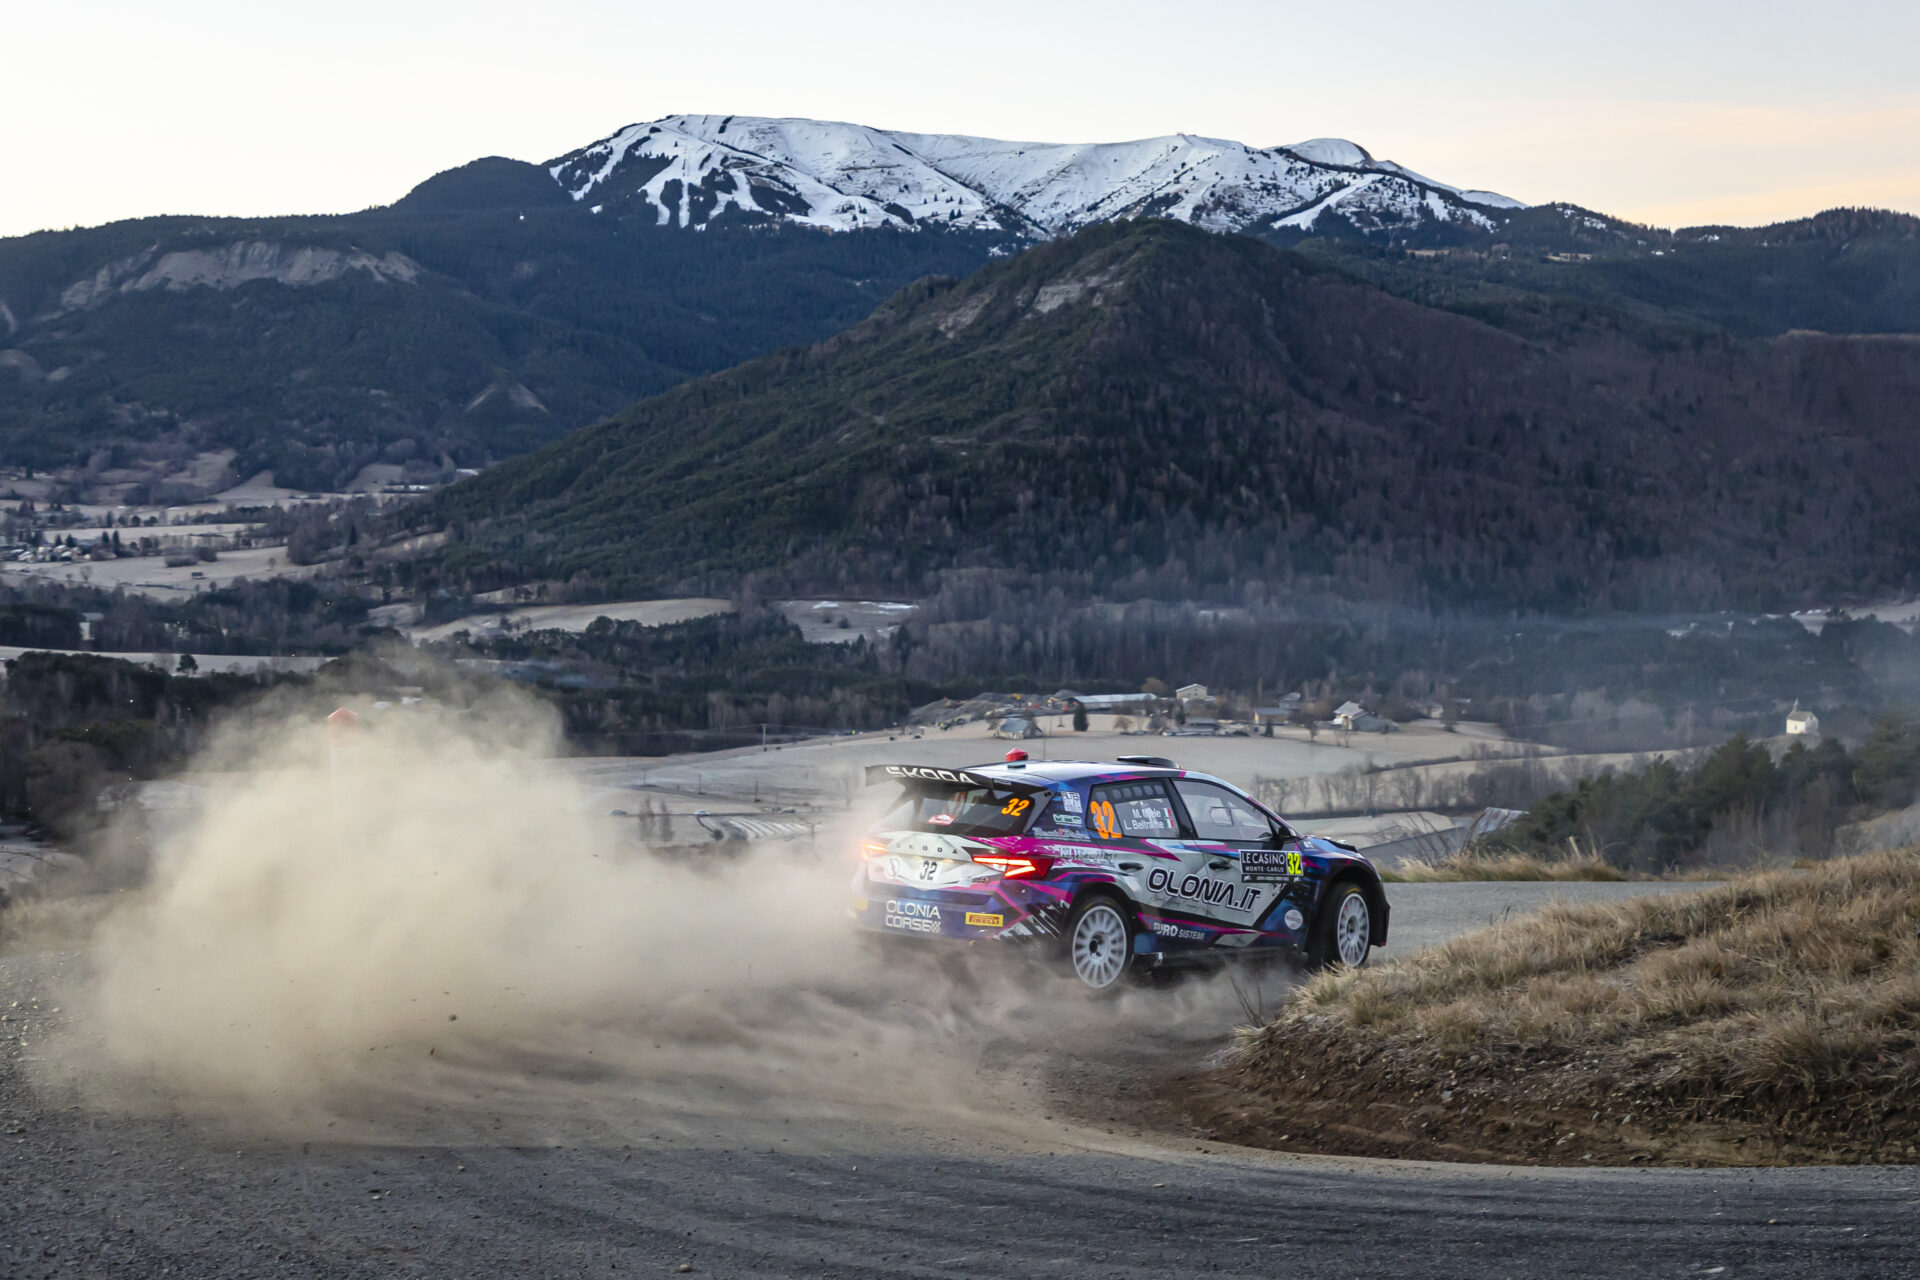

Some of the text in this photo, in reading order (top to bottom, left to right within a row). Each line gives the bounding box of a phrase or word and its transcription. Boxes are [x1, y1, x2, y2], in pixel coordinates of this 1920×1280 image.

[1001, 797, 1030, 817] 32
[1090, 800, 1122, 840] 32
[1242, 853, 1286, 865] LE CASINO
[1287, 852, 1302, 876] 32
[919, 860, 938, 881] 32
[1147, 867, 1262, 912] OLONIA.IT
[886, 899, 942, 919] OLONIA
[885, 914, 933, 933] CORSE
[968, 913, 1000, 926] PIRELLI
